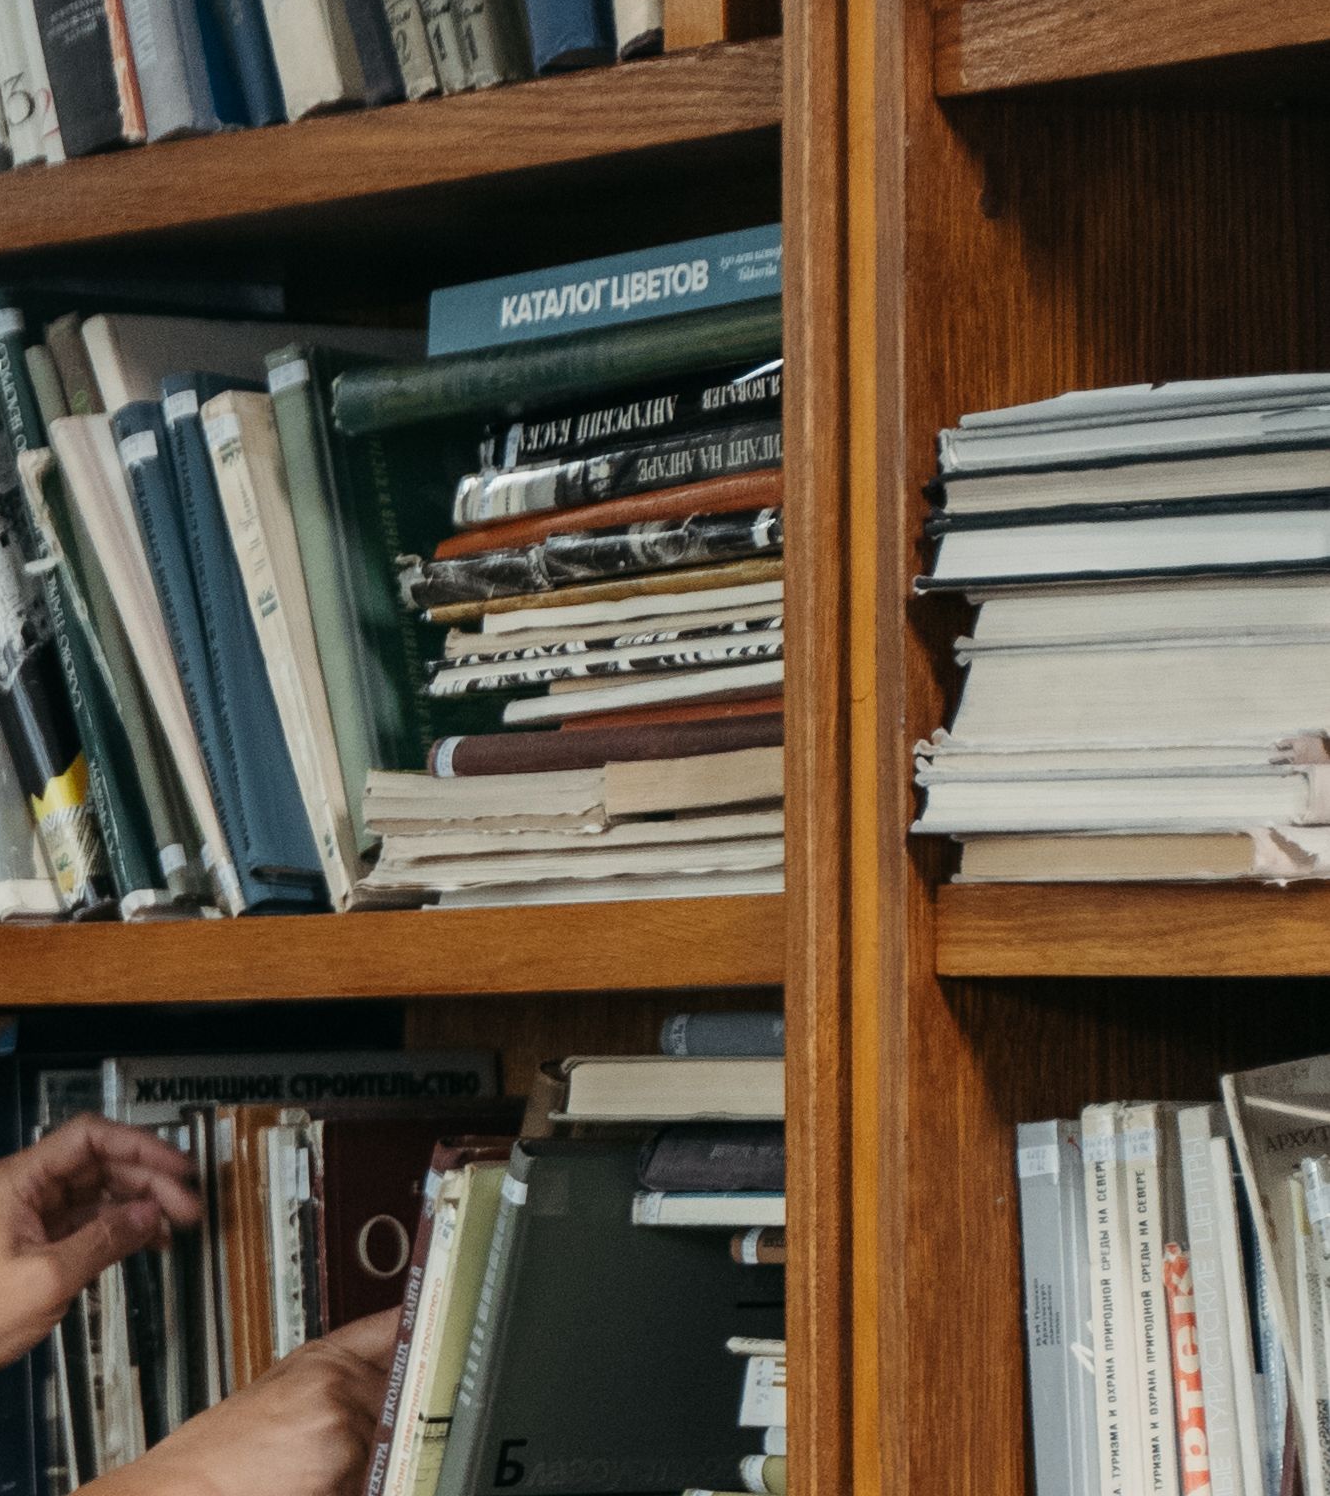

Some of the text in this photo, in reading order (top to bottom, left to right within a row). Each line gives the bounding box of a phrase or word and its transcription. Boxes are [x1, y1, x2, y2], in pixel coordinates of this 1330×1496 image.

[499, 259, 710, 328] КАТАЛОГ ЦВЕТОВ
[576, 393, 679, 444] АНГАРСКИЙ
[637, 441, 724, 484] НА АНГАРЕ
[135, 1069, 481, 1104] ЖИЛИЩНОЕ СТРОИТЕЛЬСТВО
[1136, 1168, 1149, 1211] СЕВЕРЕ
[1101, 1225, 1112, 1273] СРЕДЫ
[1141, 1240, 1153, 1283] СРЕДЫ
[1104, 1276, 1116, 1353] ПРИРОДНОЙ
[1145, 1287, 1158, 1362] ПРИРОДНОЙ
[382, 1342, 410, 1429] ШКОЛЬНЫХ
[402, 1264, 424, 1332] ЗДАНИЙ
[1107, 1355, 1118, 1404] ОХРАНА
[1149, 1364, 1160, 1415] ОХРАНА
[1110, 1424, 1122, 1480] ТУРИЗМА
[1152, 1431, 1165, 1490] ТУРИЗМА
